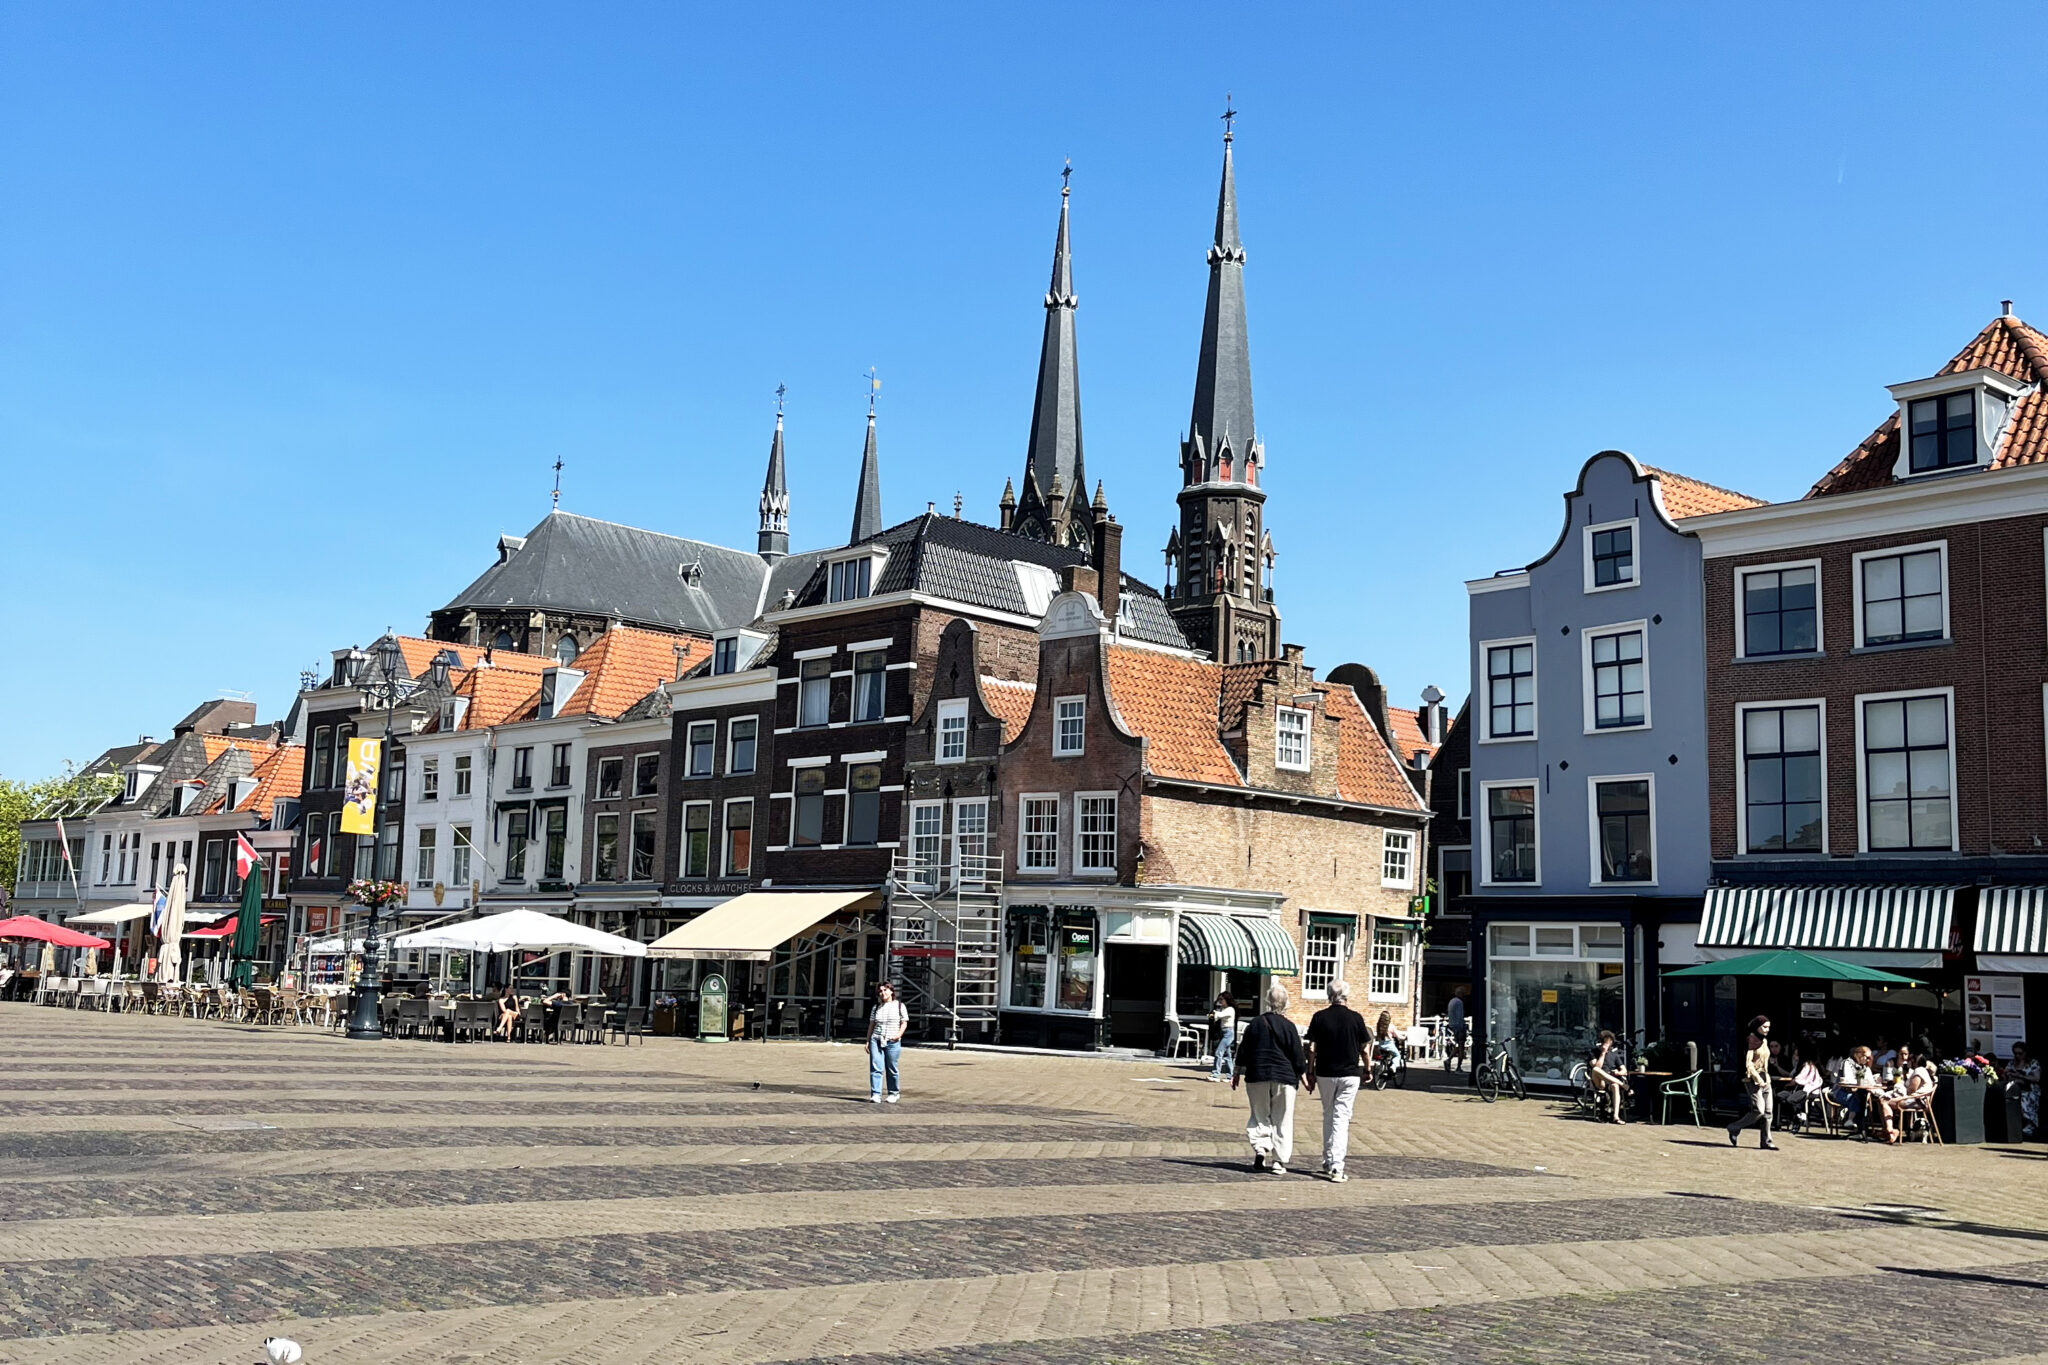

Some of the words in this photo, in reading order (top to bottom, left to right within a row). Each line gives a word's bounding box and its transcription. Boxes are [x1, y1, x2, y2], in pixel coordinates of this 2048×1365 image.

[669, 884, 703, 893] CLOCKS
[704, 884, 711, 893] &
[1071, 932, 1090, 942] Open
[1018, 944, 1047, 955] SUBWA
